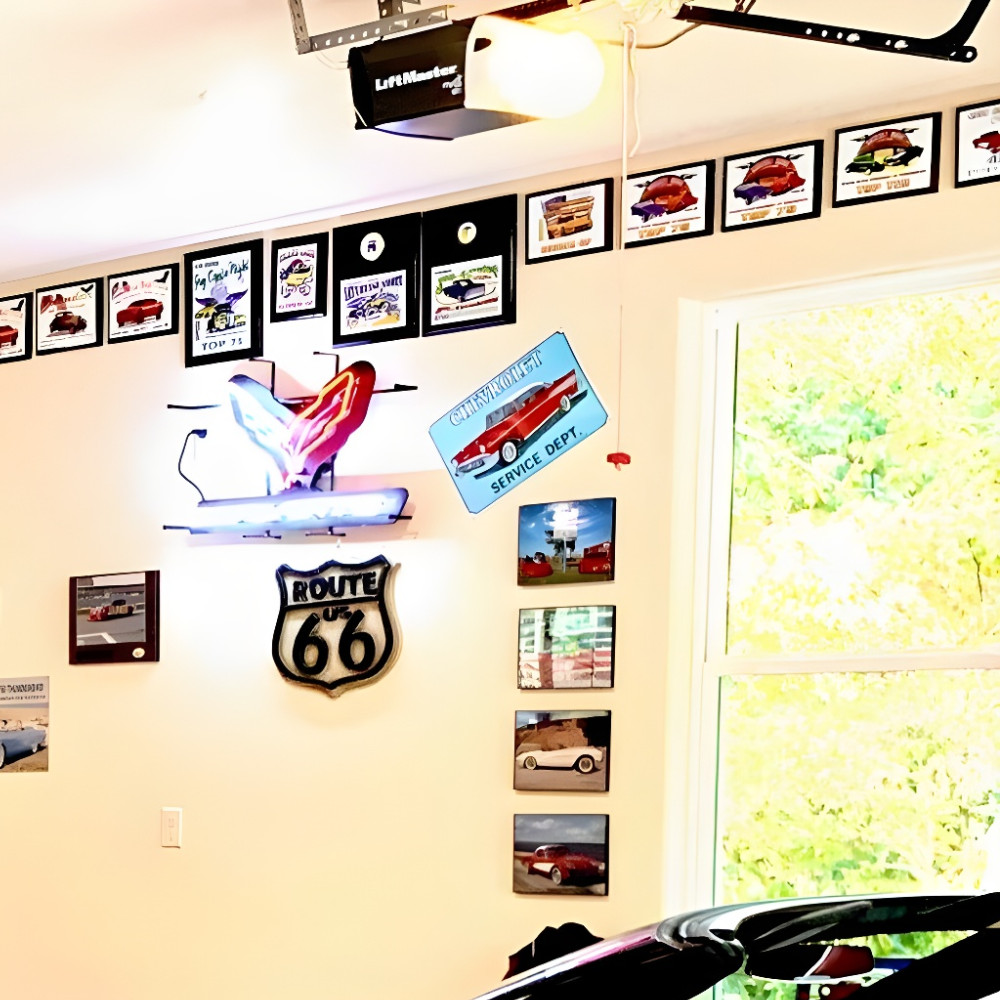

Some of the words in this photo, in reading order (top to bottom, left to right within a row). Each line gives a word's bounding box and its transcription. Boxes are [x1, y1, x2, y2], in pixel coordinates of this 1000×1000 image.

[375, 64, 457, 91] LiftMaster
[450, 349, 543, 426] CHEVROLET
[490, 451, 543, 494] SERVICE
[293, 571, 377, 603] ROUTE
[293, 609, 376, 675] 66
